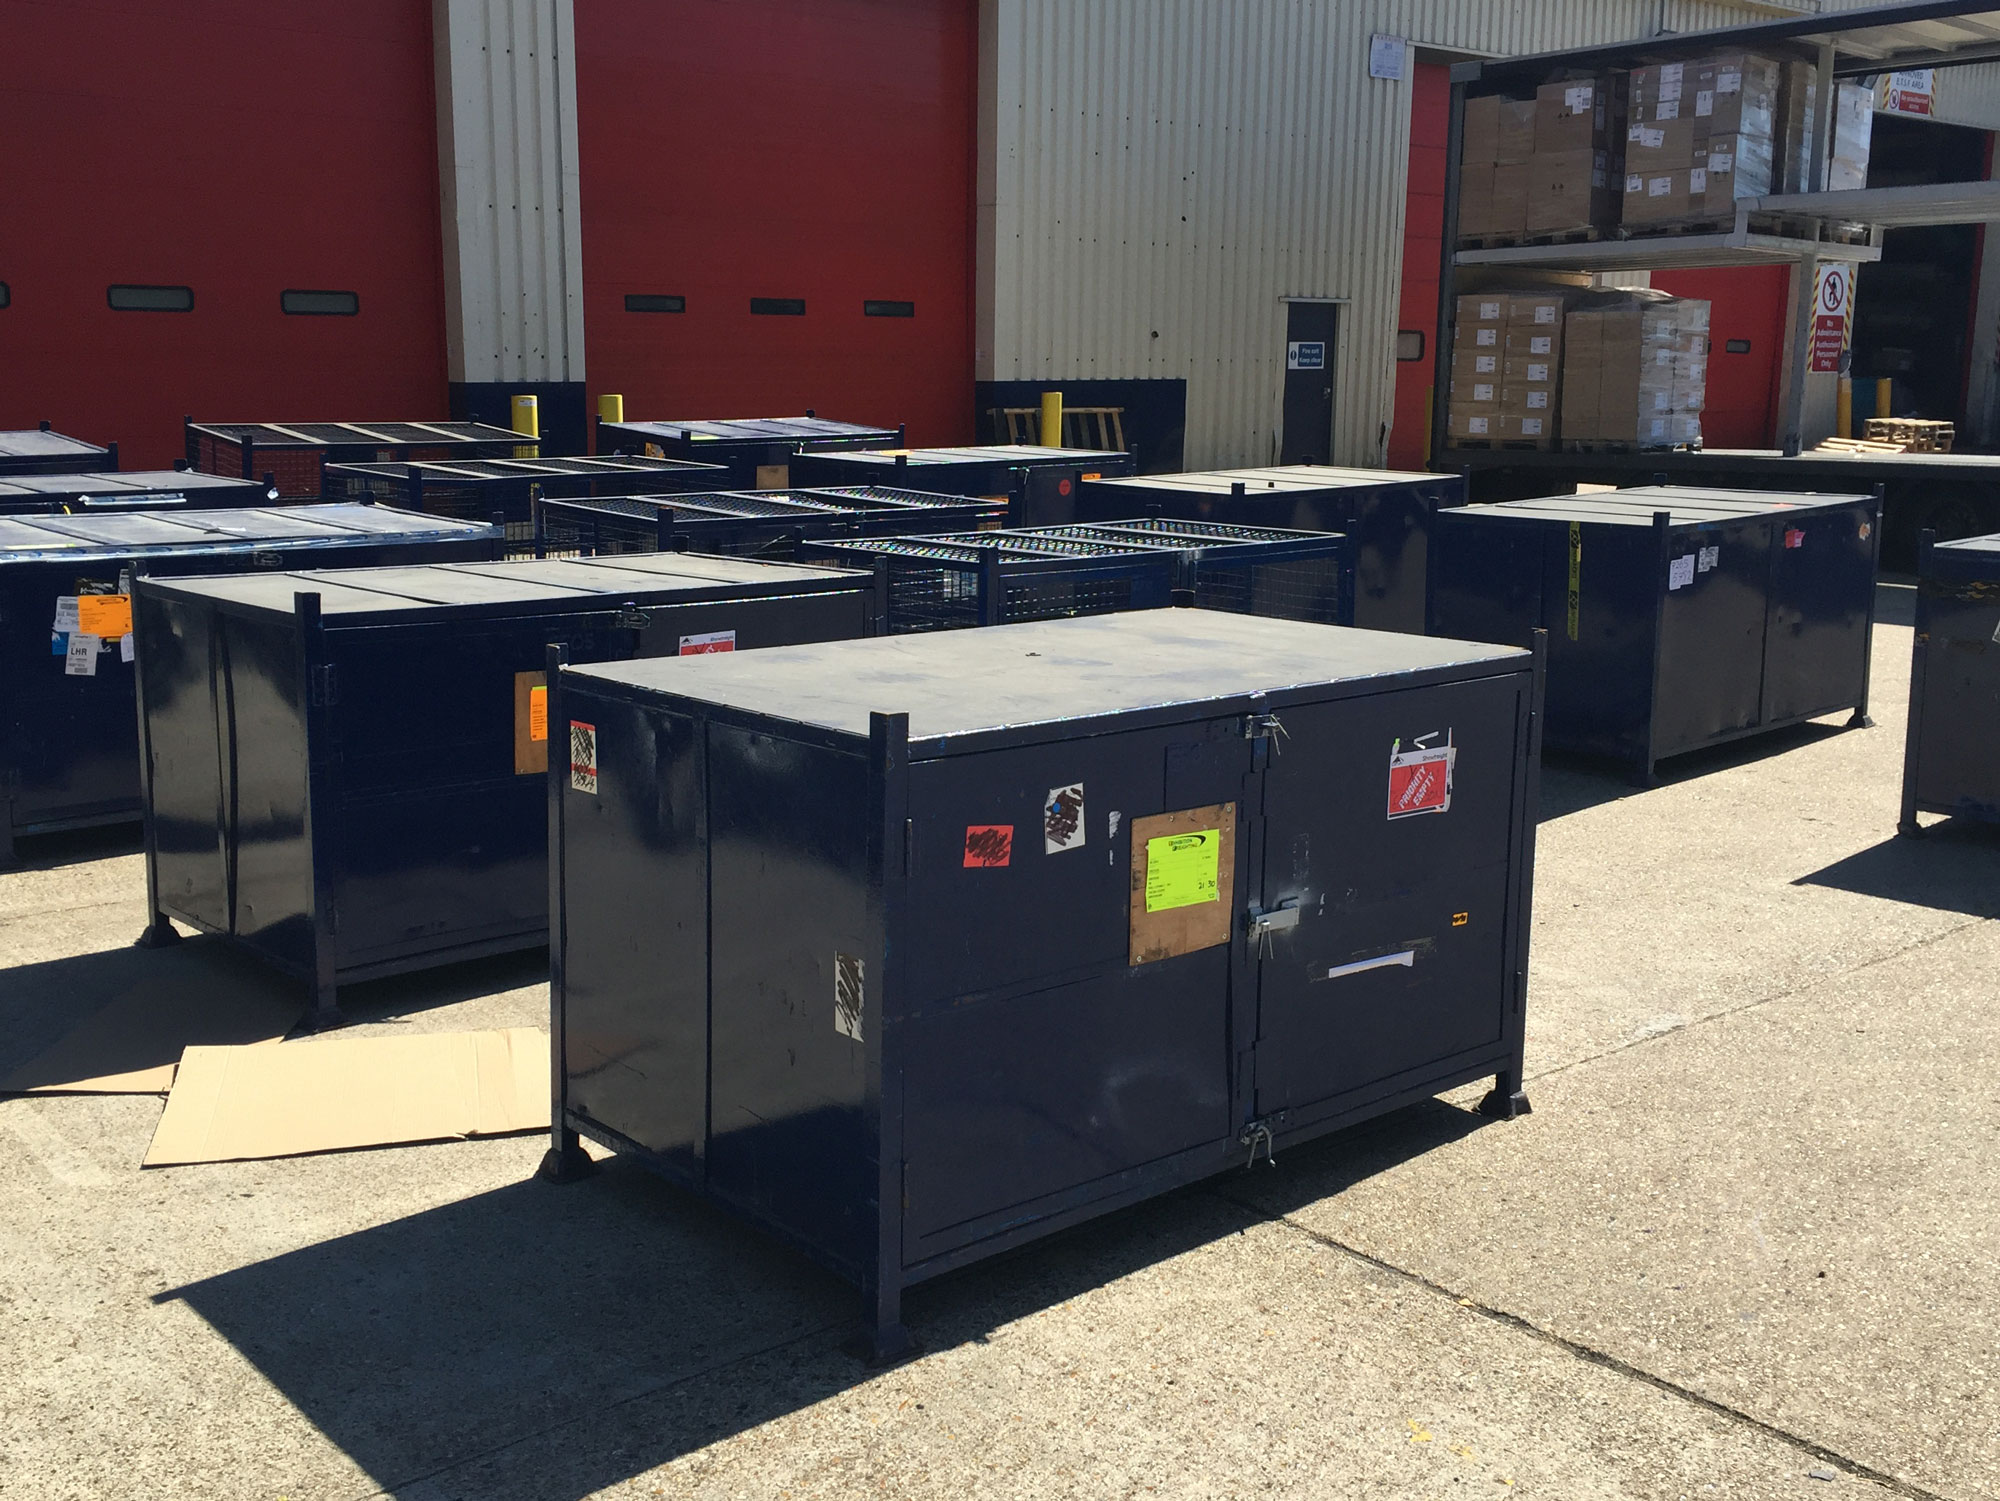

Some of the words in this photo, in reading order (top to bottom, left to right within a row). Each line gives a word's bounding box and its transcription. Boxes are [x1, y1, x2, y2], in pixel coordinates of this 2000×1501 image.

[1821, 360, 1832, 368] Only
[70, 647, 87, 656] LHR
[1399, 766, 1426, 809] PRIORITY
[1413, 771, 1435, 806] EMPTY
